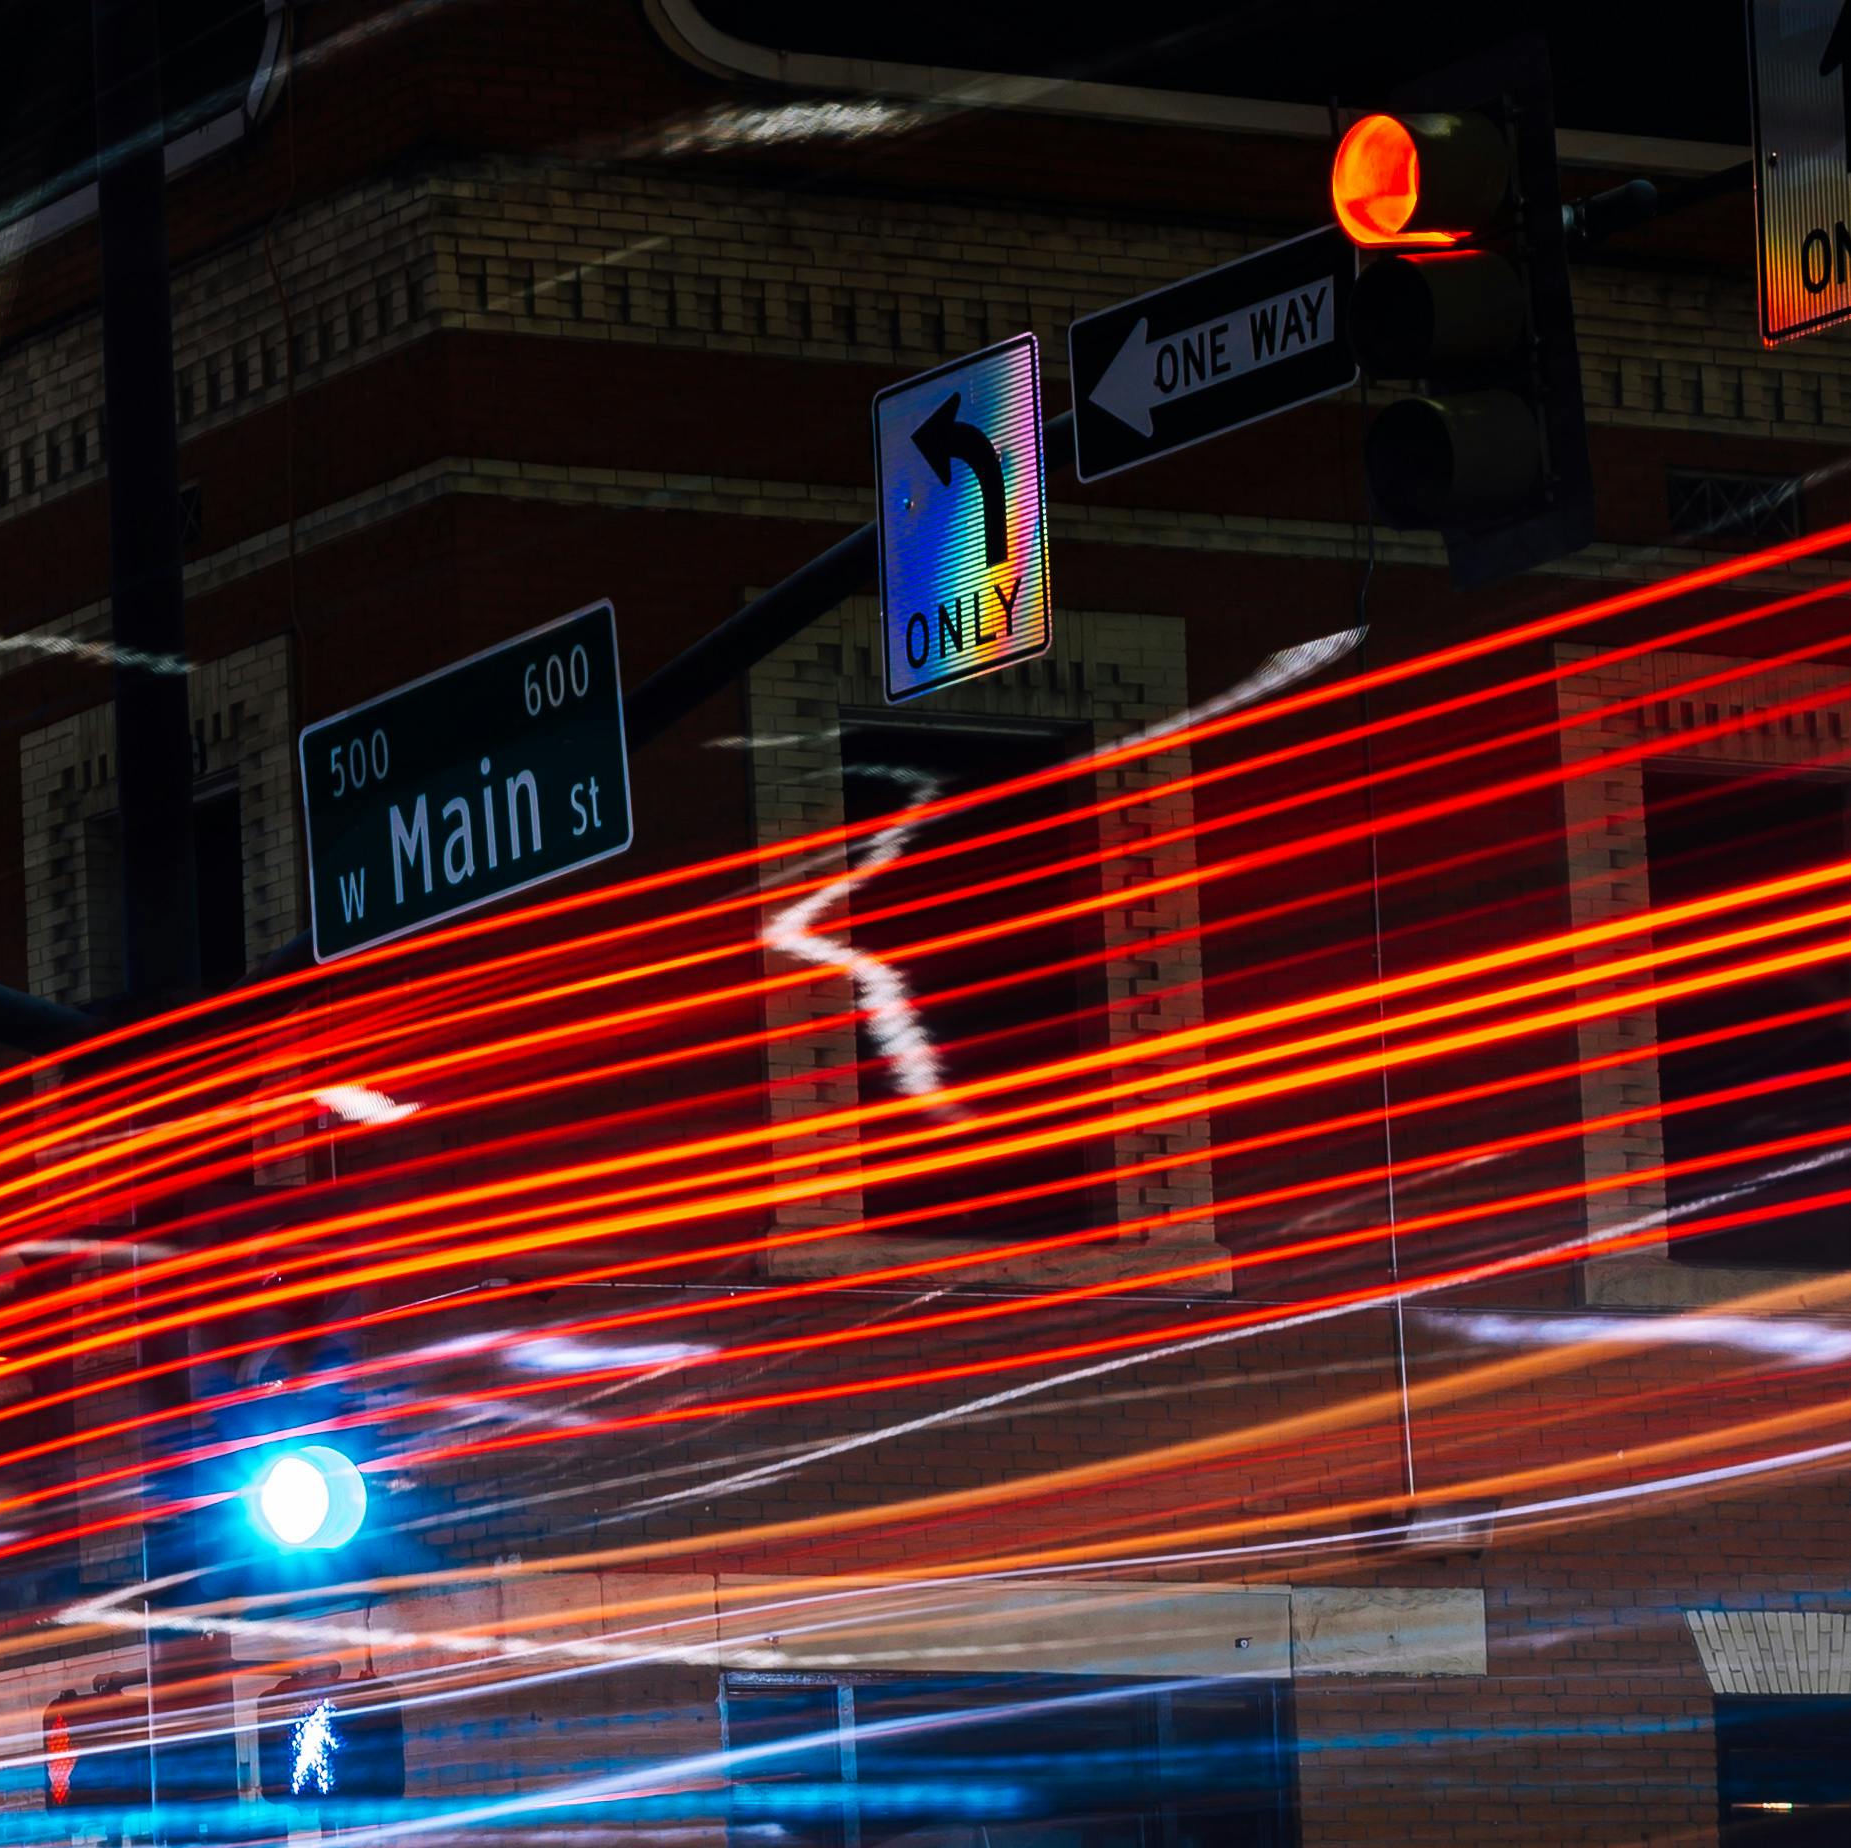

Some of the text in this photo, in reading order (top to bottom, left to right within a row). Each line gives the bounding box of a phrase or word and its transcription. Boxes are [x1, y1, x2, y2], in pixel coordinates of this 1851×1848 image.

[1158, 287, 1327, 393] ONE WAY
[907, 576, 1022, 668] ONLY
[524, 644, 589, 717] 600
[330, 727, 389, 798] 500
[339, 756, 602, 924] W Main St
